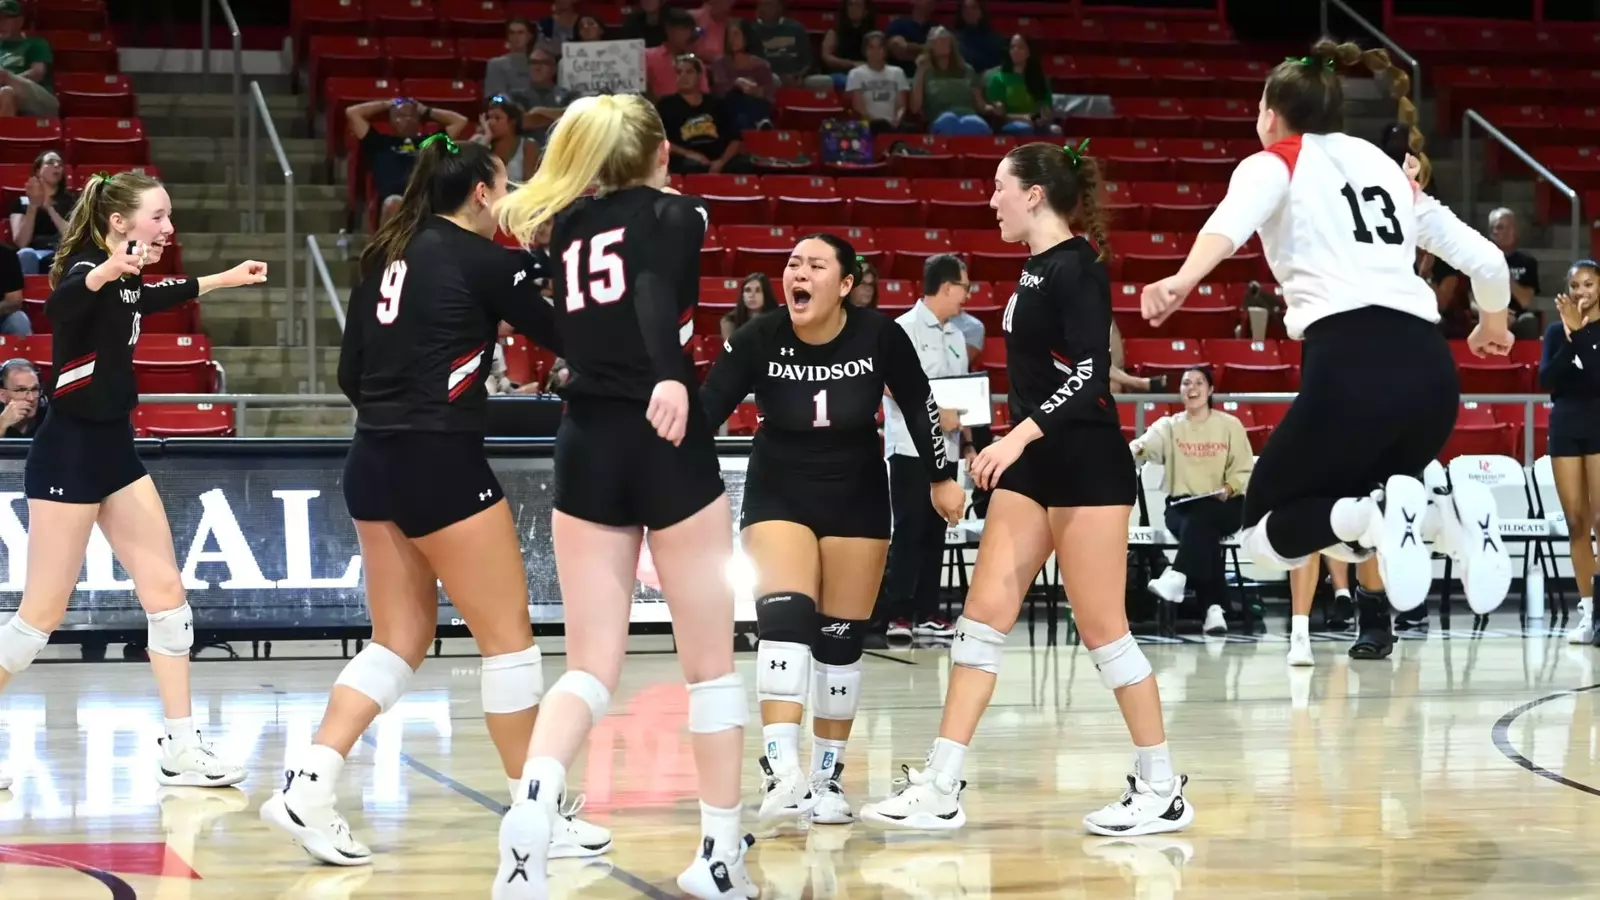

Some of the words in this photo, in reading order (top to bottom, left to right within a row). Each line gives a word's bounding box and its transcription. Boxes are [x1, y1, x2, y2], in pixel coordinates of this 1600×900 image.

[1340, 181, 1404, 245] 13
[376, 259, 408, 325] 9
[562, 227, 626, 313] 15
[767, 357, 875, 382] DAVIDSON
[812, 389, 831, 427] 1
